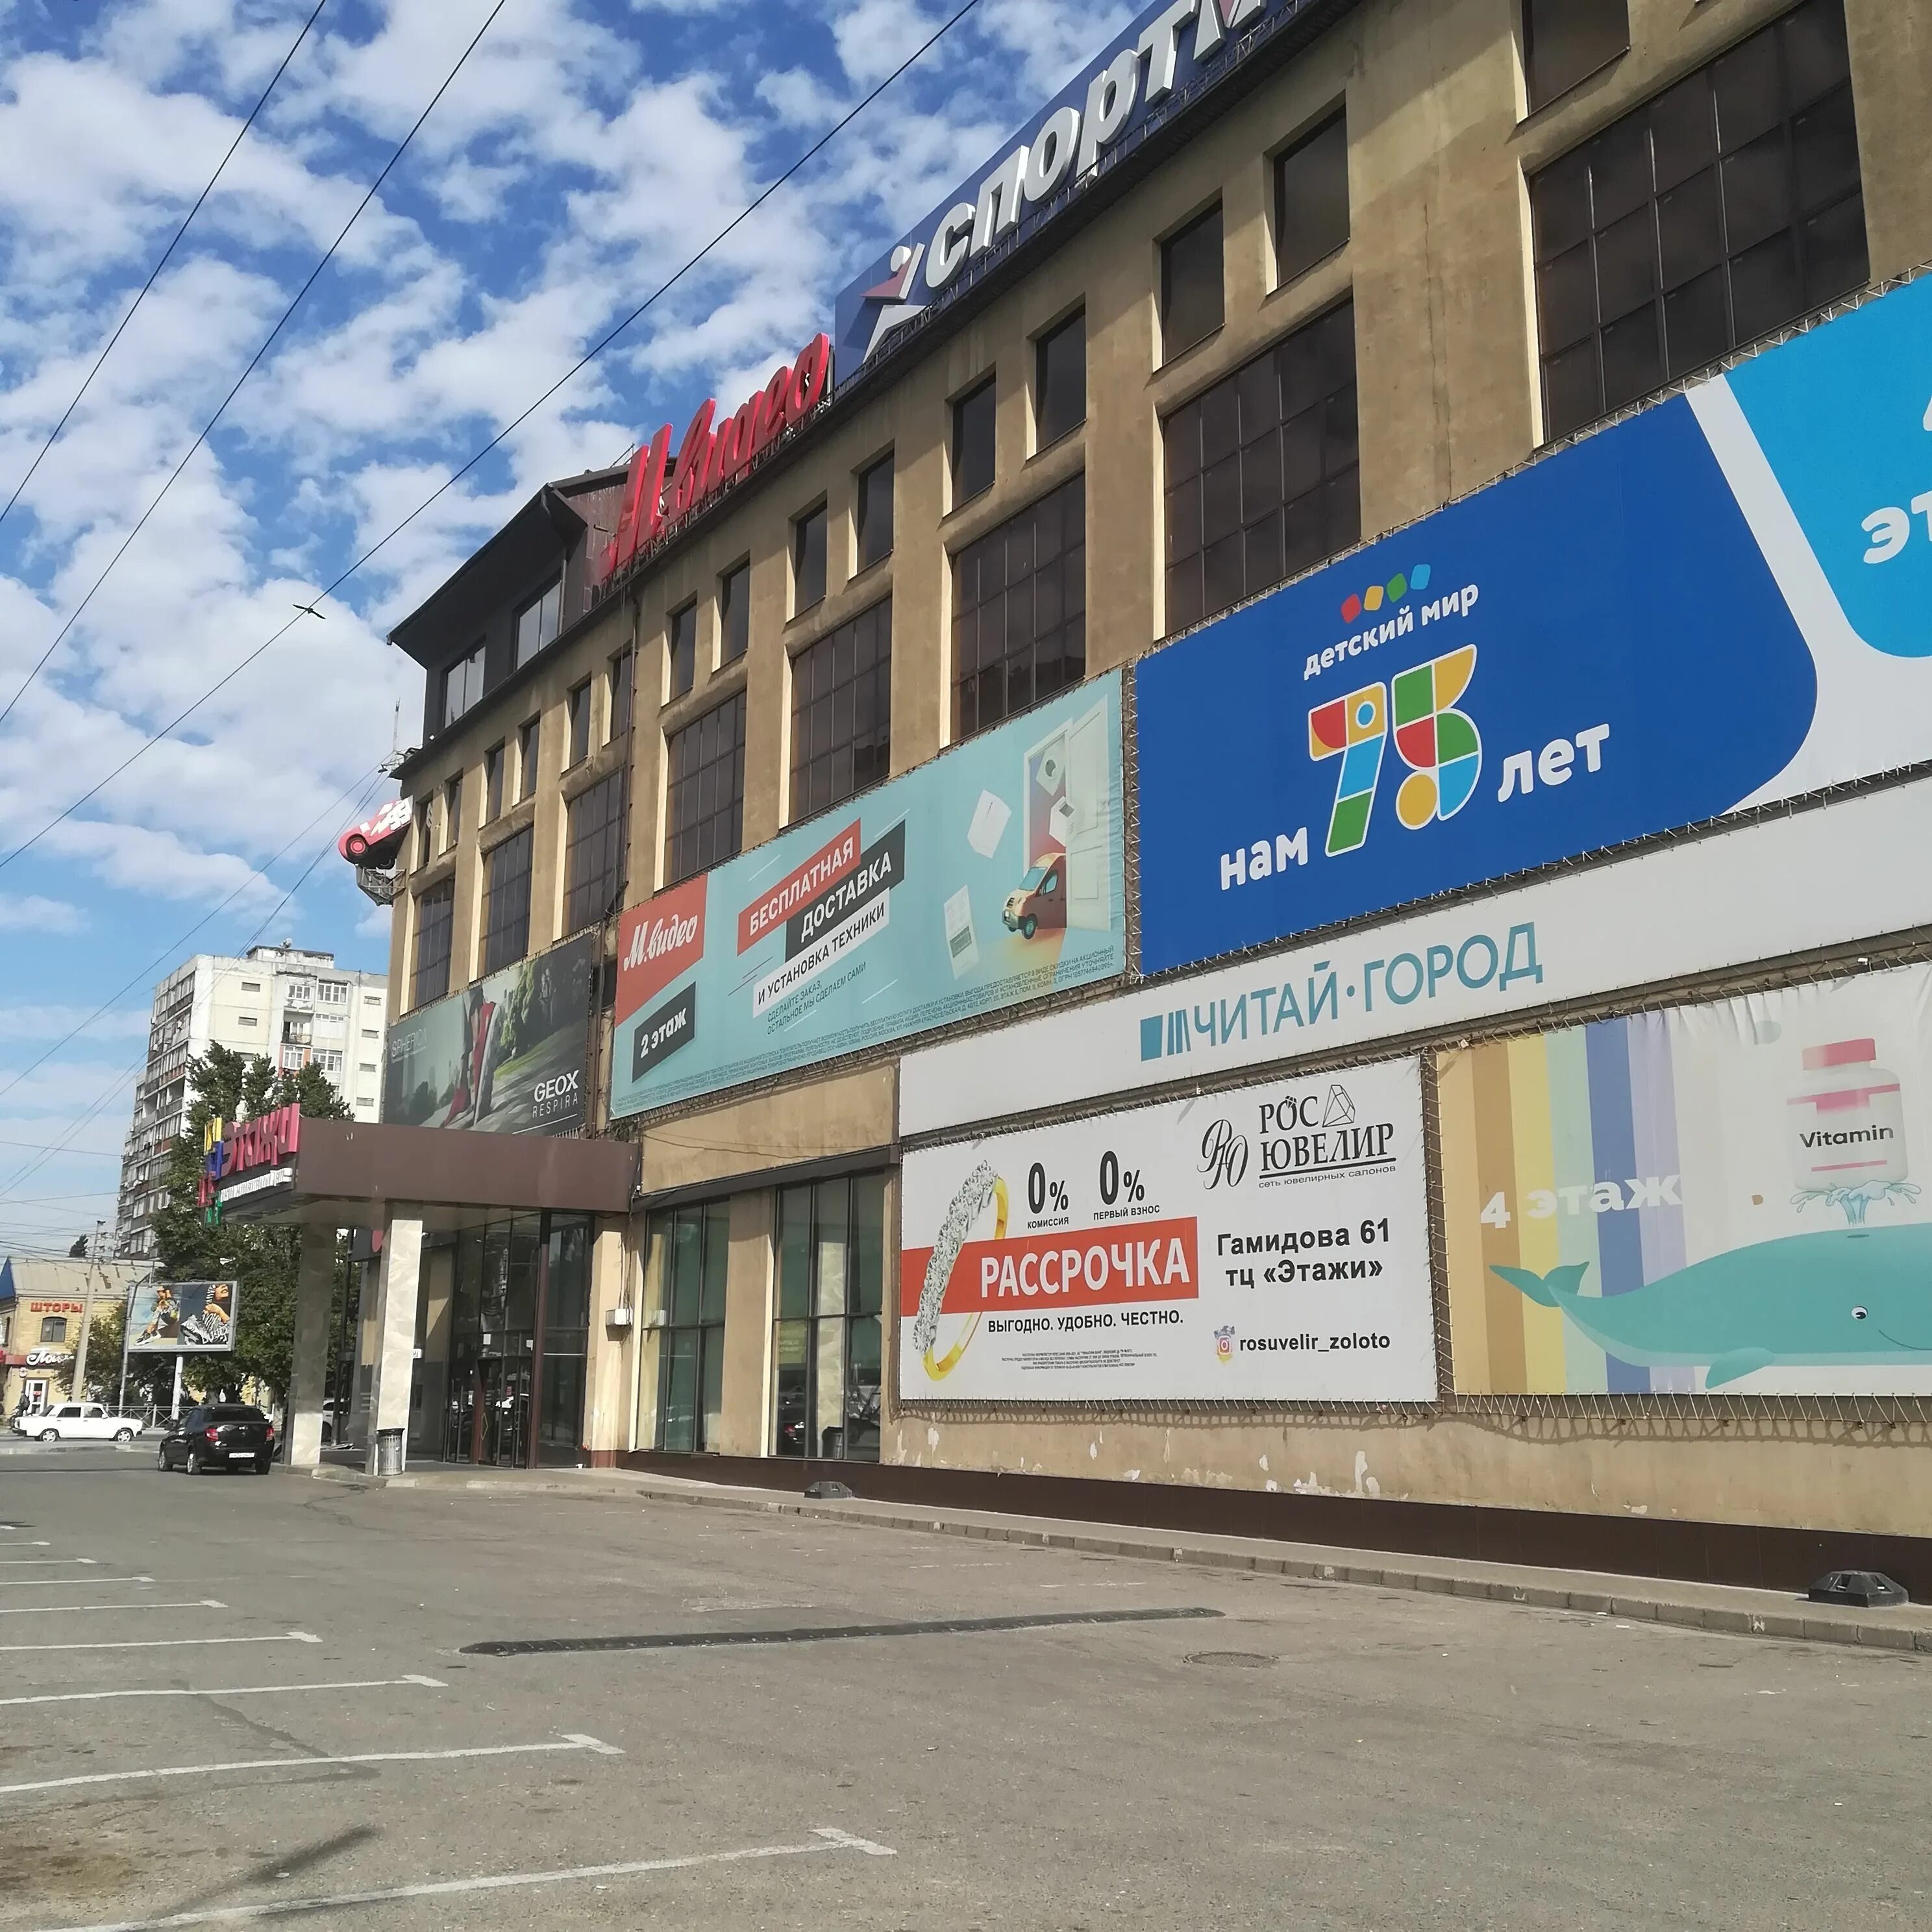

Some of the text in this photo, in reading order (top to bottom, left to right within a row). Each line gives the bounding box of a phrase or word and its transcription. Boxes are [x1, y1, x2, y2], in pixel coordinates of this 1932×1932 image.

[1304, 583, 1480, 680] детский мир
[1220, 643, 1611, 890] нам 75 лет
[750, 836, 853, 935] БЕСПЛАТНАЯ
[801, 852, 891, 943] ДОСТАВКА
[623, 914, 698, 972] М.видео
[758, 902, 884, 1005] И УСТАНОВКА ТЕХНИКИ
[767, 961, 866, 1035] ОСТАЛЬНОЕ МЫ СДЕЛАЕМ САМИ
[767, 980, 822, 1022] СДЕЛАЙТЕ ЗАКАЗ,
[640, 1008, 687, 1059] 2 этаж
[532, 1092, 578, 1119] RESPIRA
[534, 1070, 579, 1102] GEOX
[1259, 1095, 1319, 1133] РОС
[1260, 1122, 1394, 1171] ЮВЕЛИР
[1799, 1124, 1894, 1150] Vitamin
[1259, 1166, 1396, 1189] сеть ювелирных салонов
[1093, 1204, 1160, 1221] ПЕРВЫЙ ВЗНОС
[1480, 1174, 1683, 1229] 4 этаж
[1027, 1216, 1069, 1230] КОМИССИЯ
[1217, 1218, 1390, 1257] Гамидова 61
[980, 1236, 1191, 1298] РАССРОЧКА
[1263, 1258, 1383, 1285] «Этажи»
[31, 1302, 84, 1313] ШТОРЫ
[987, 1309, 1183, 1333] ВЫГОДНО. УДОБНО. ЧЕСТНО.
[1239, 1330, 1391, 1354] rosuvelir_zoloto
